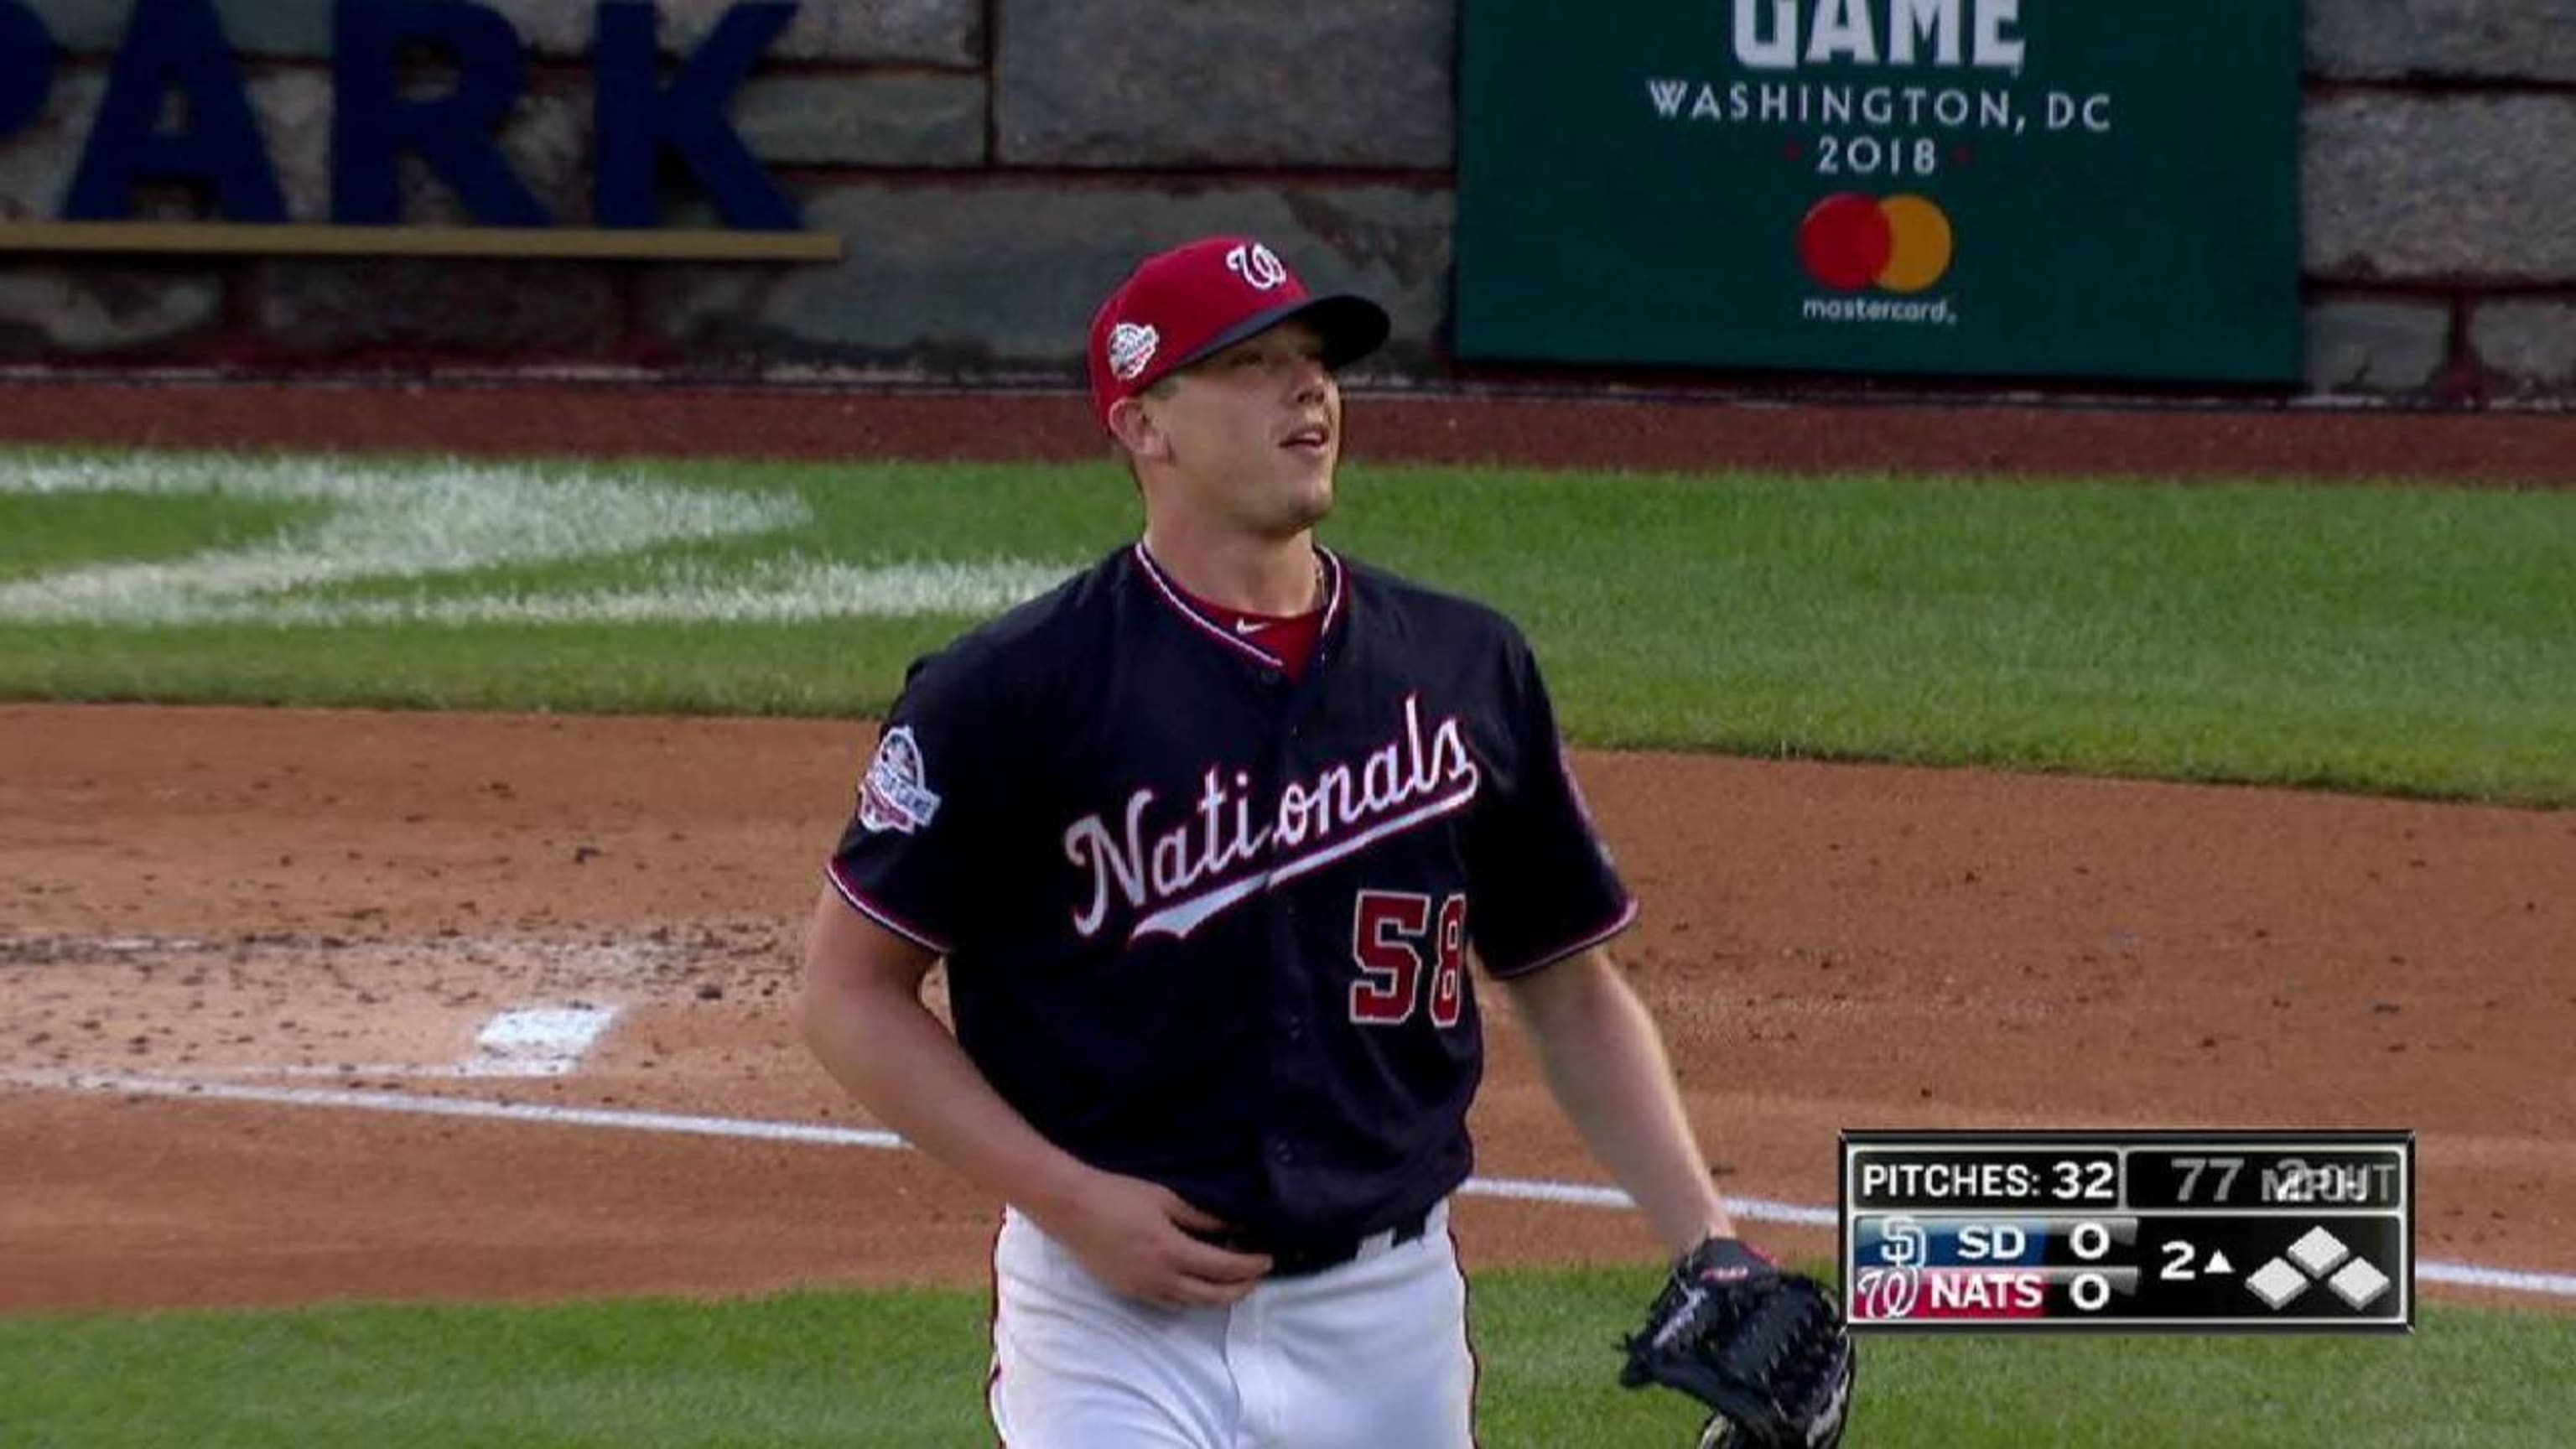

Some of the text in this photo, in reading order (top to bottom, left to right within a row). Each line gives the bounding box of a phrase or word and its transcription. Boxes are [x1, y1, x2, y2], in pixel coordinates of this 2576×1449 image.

[1732, 0, 2026, 69] GAME
[1649, 80, 2113, 134] WASHINGTON, DC
[1816, 136, 1938, 174] 2018
[1062, 692, 1480, 948] Nationals
[1348, 889, 1467, 1028] 58
